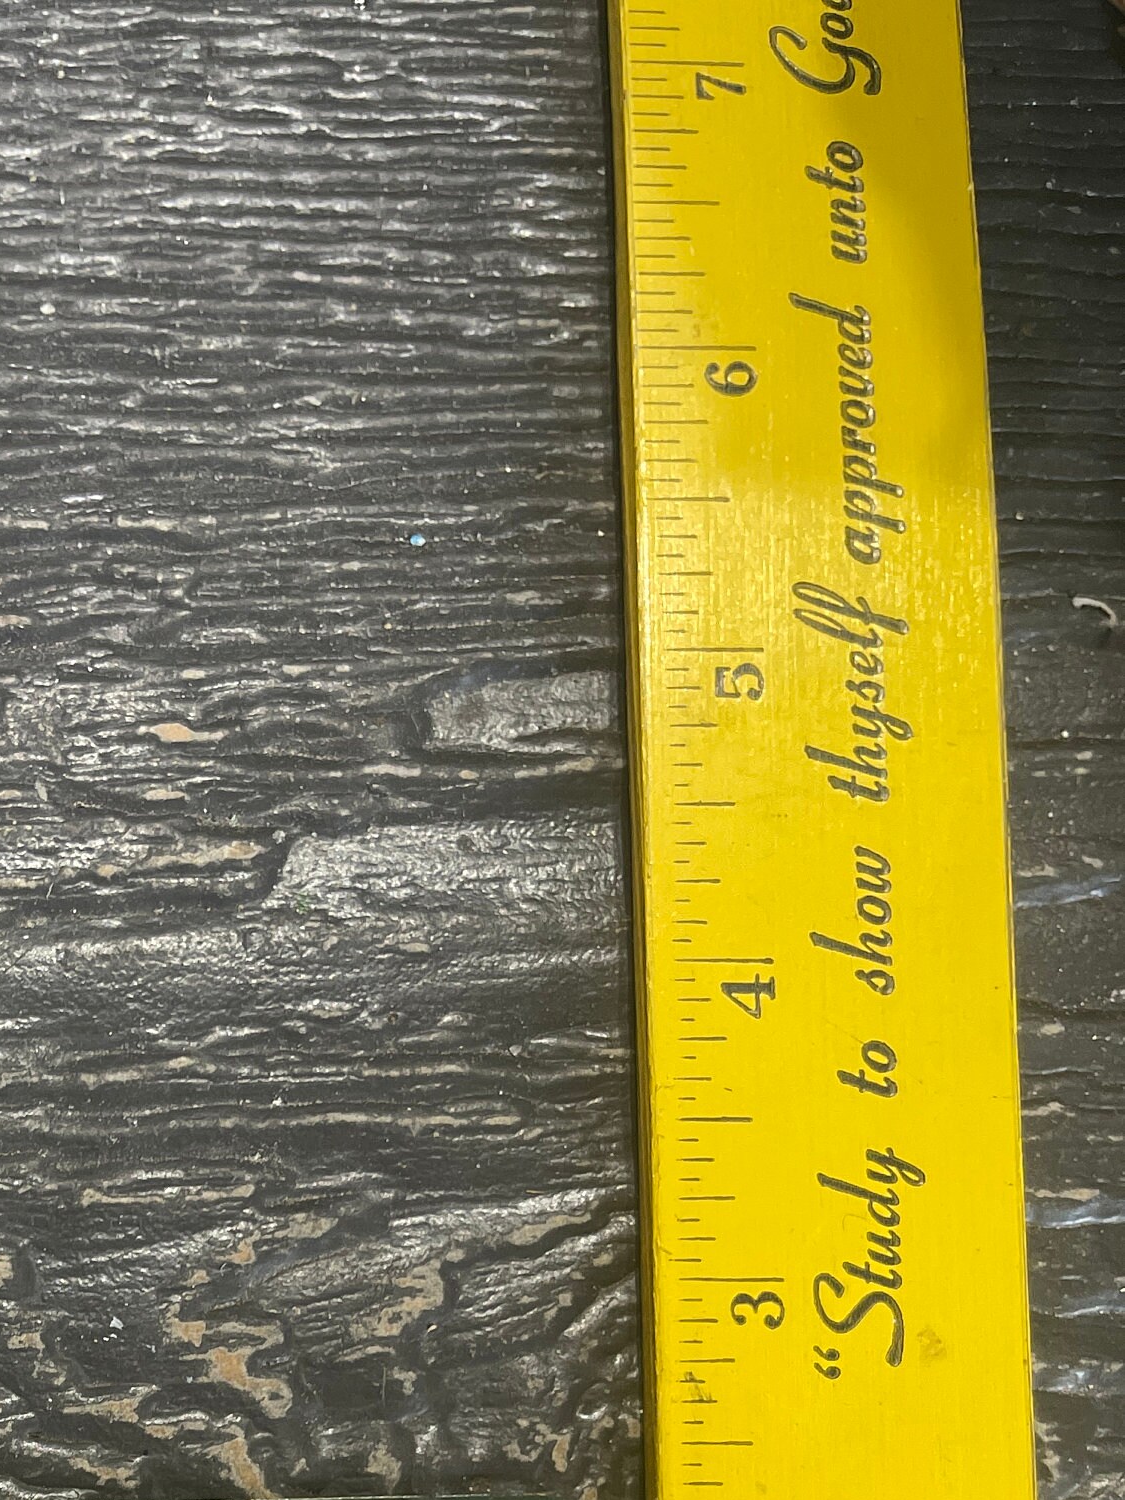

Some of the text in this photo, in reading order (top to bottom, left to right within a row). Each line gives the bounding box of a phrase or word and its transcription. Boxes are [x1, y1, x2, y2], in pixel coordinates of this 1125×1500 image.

[695, 73, 747, 101] 7
[805, 140, 868, 264] unto
[703, 360, 759, 396] 6
[789, 292, 905, 565] approved
[714, 662, 765, 701] 5
[792, 583, 914, 804] thyself
[809, 845, 895, 996] show
[720, 973, 775, 1019] 4
[837, 1039, 898, 1098] to
[732, 1290, 784, 1330] 3
